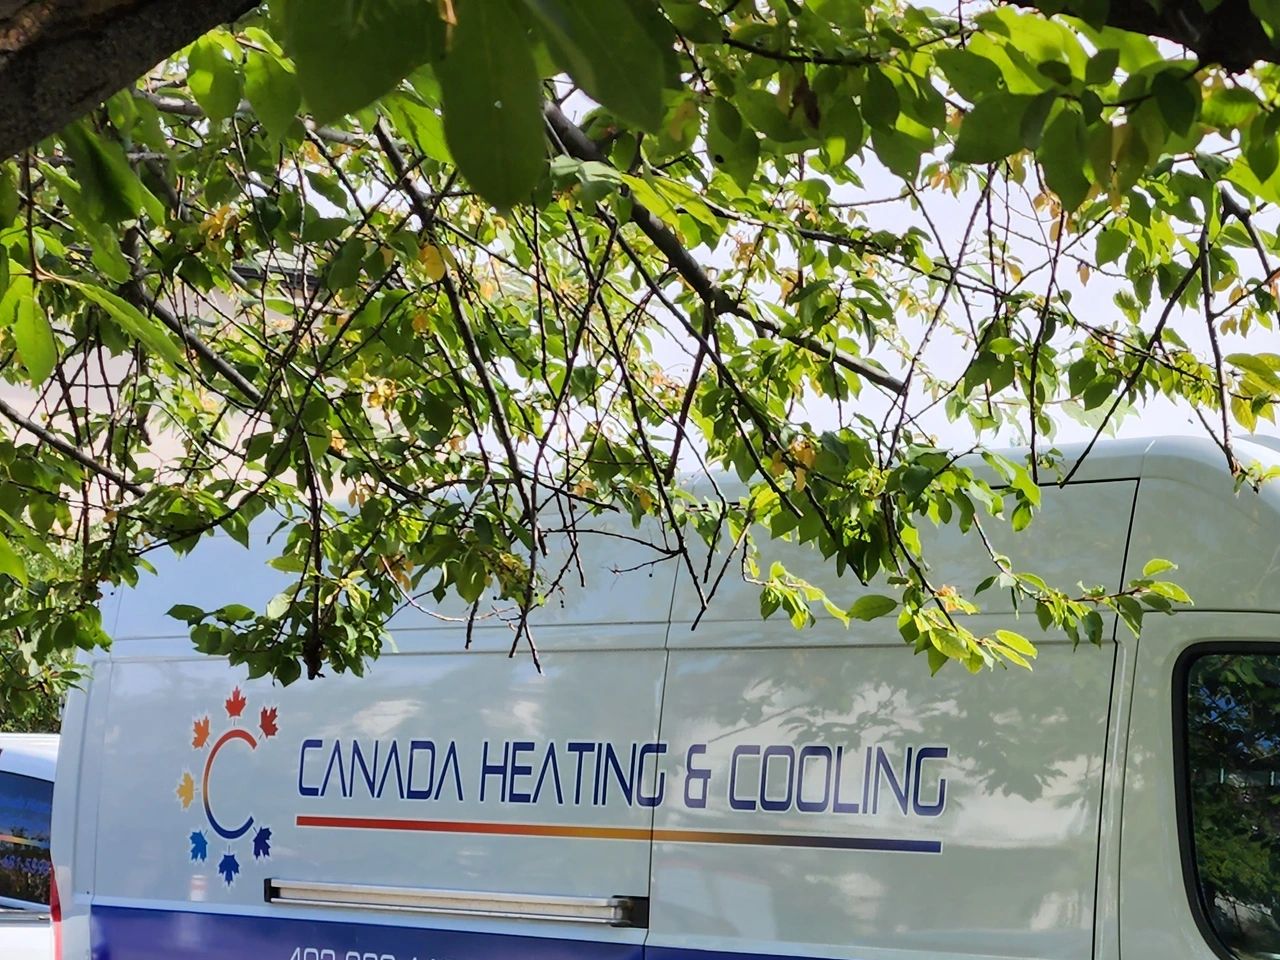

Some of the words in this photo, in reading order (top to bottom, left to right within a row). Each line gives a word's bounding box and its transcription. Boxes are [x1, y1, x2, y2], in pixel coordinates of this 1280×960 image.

[298, 739, 464, 799] CANADA
[480, 741, 667, 808] HEATING
[685, 743, 711, 809] &
[729, 745, 949, 816] COOLING
